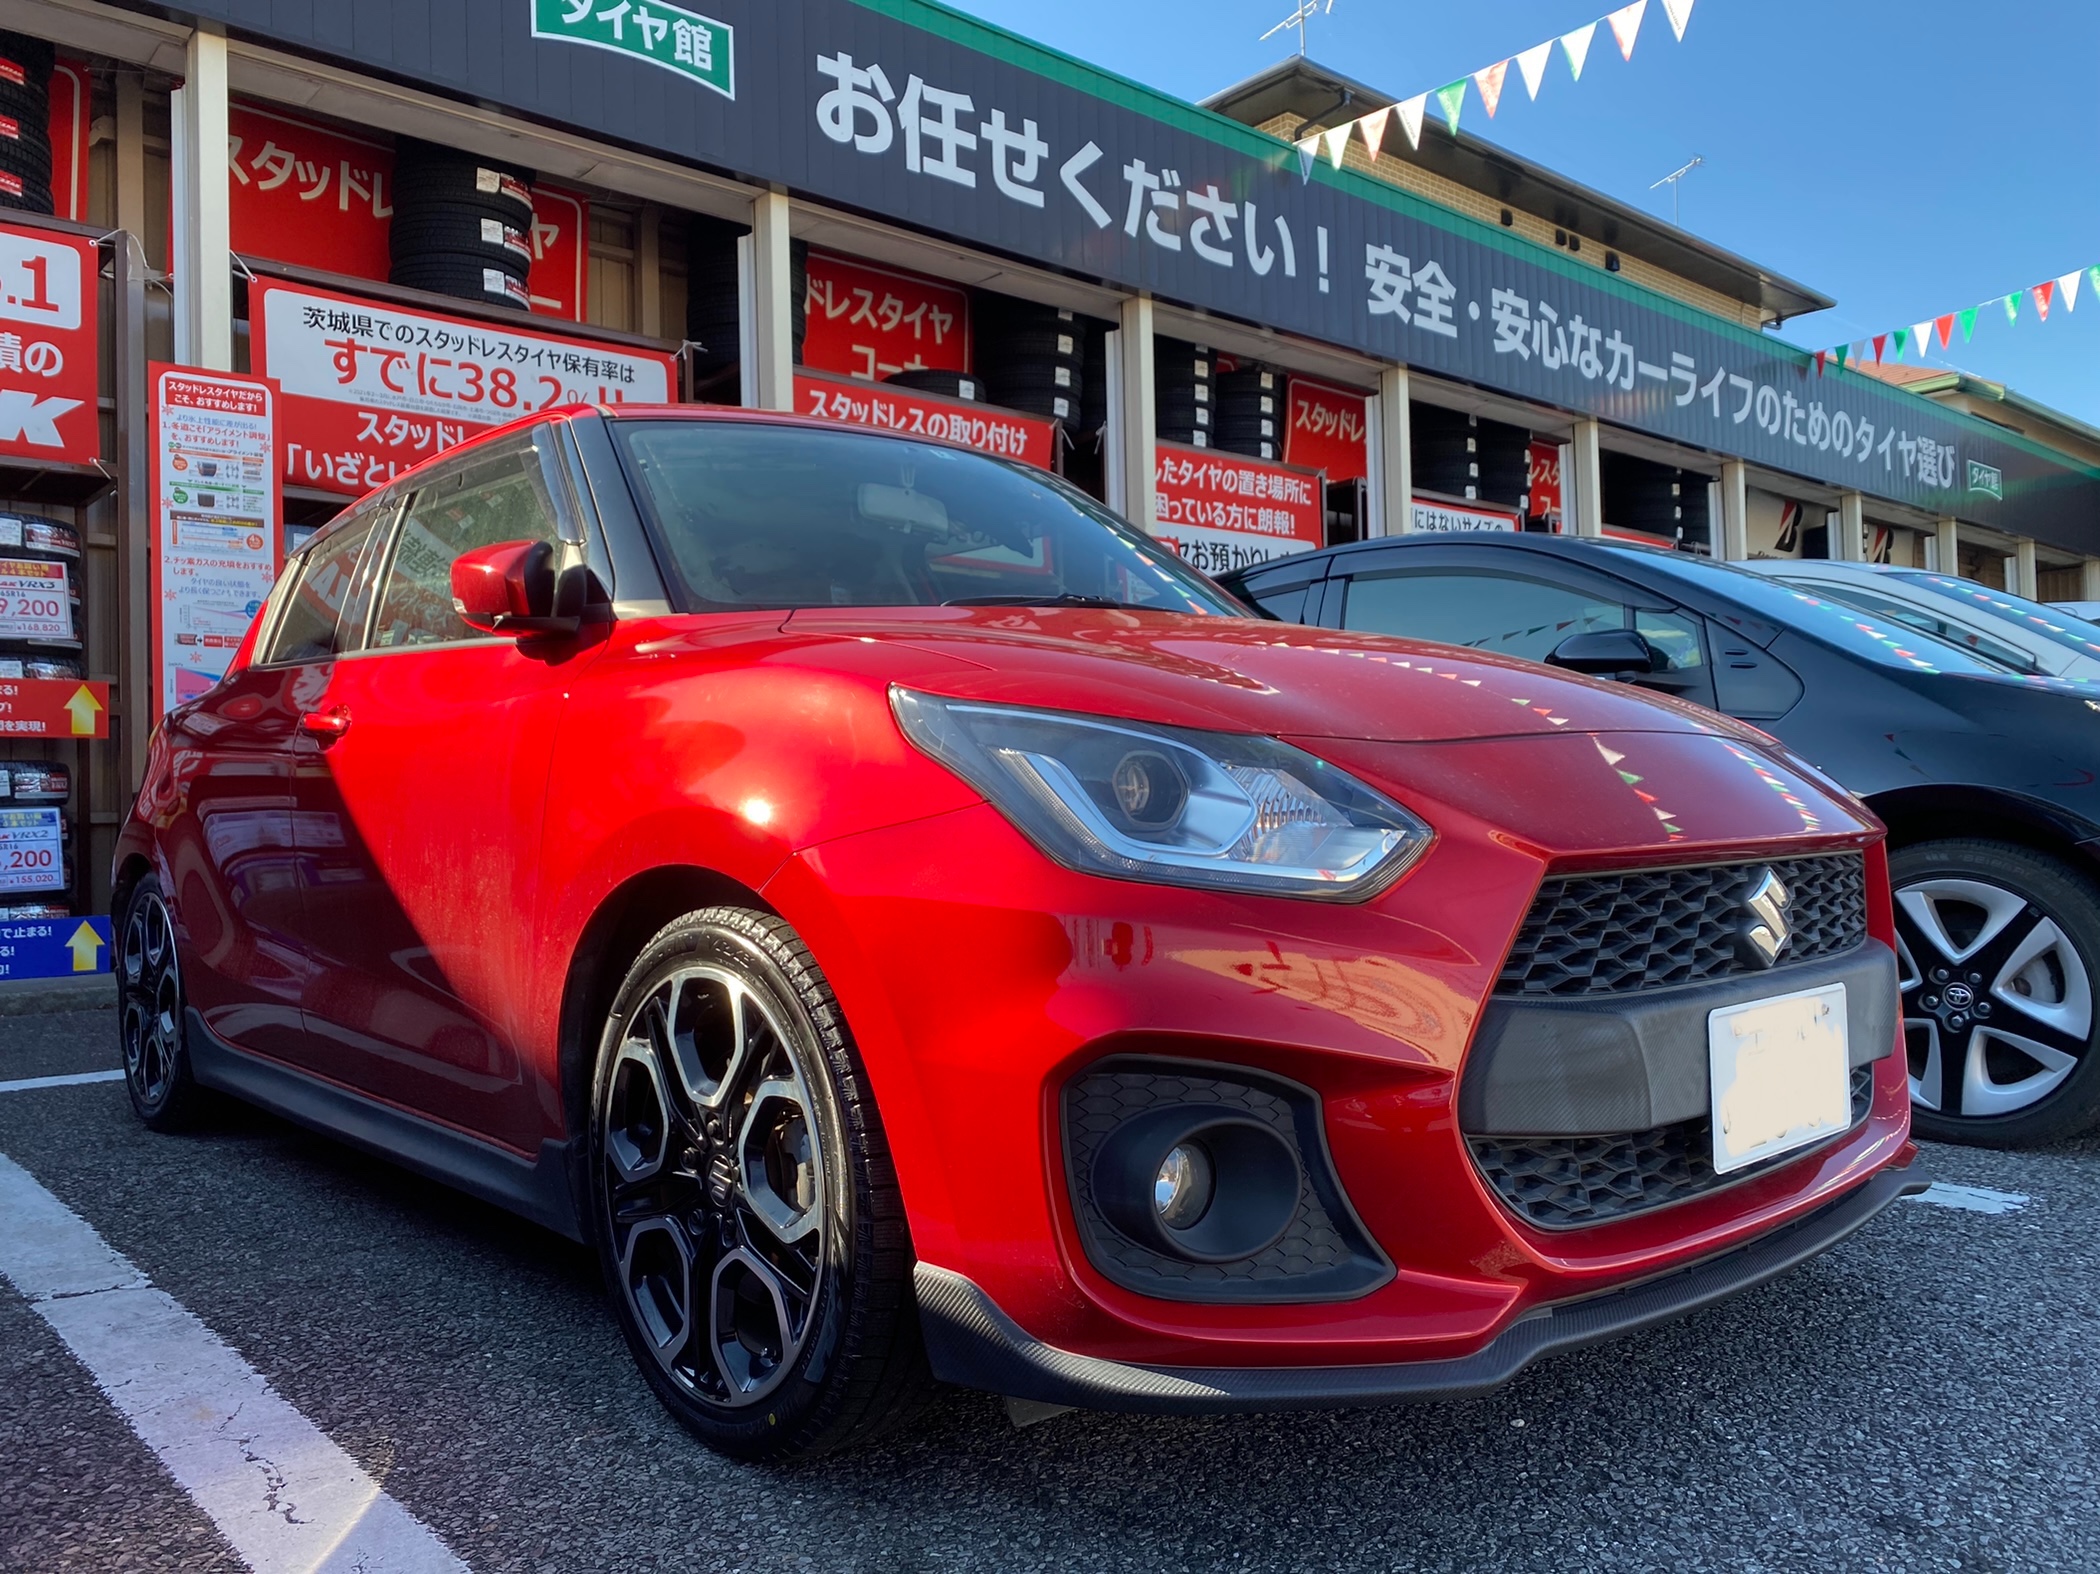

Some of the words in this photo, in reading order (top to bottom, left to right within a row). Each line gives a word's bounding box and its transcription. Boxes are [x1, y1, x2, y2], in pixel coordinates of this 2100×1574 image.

[0, 255, 59, 313] .1
[815, 51, 1330, 293] お任せください!
[1364, 243, 1956, 489] 安全・安心なカーライフのためのタイヤ選び
[302, 306, 636, 384] 茨城県でのスタッドレスタイヤ保有率は
[168, 381, 263, 401] スタッドレスタイヤだから
[174, 393, 257, 412] こそ、おすすめします!
[809, 390, 1028, 455] スタッドレスの取り付け
[1295, 400, 1367, 443] スタッドレ
